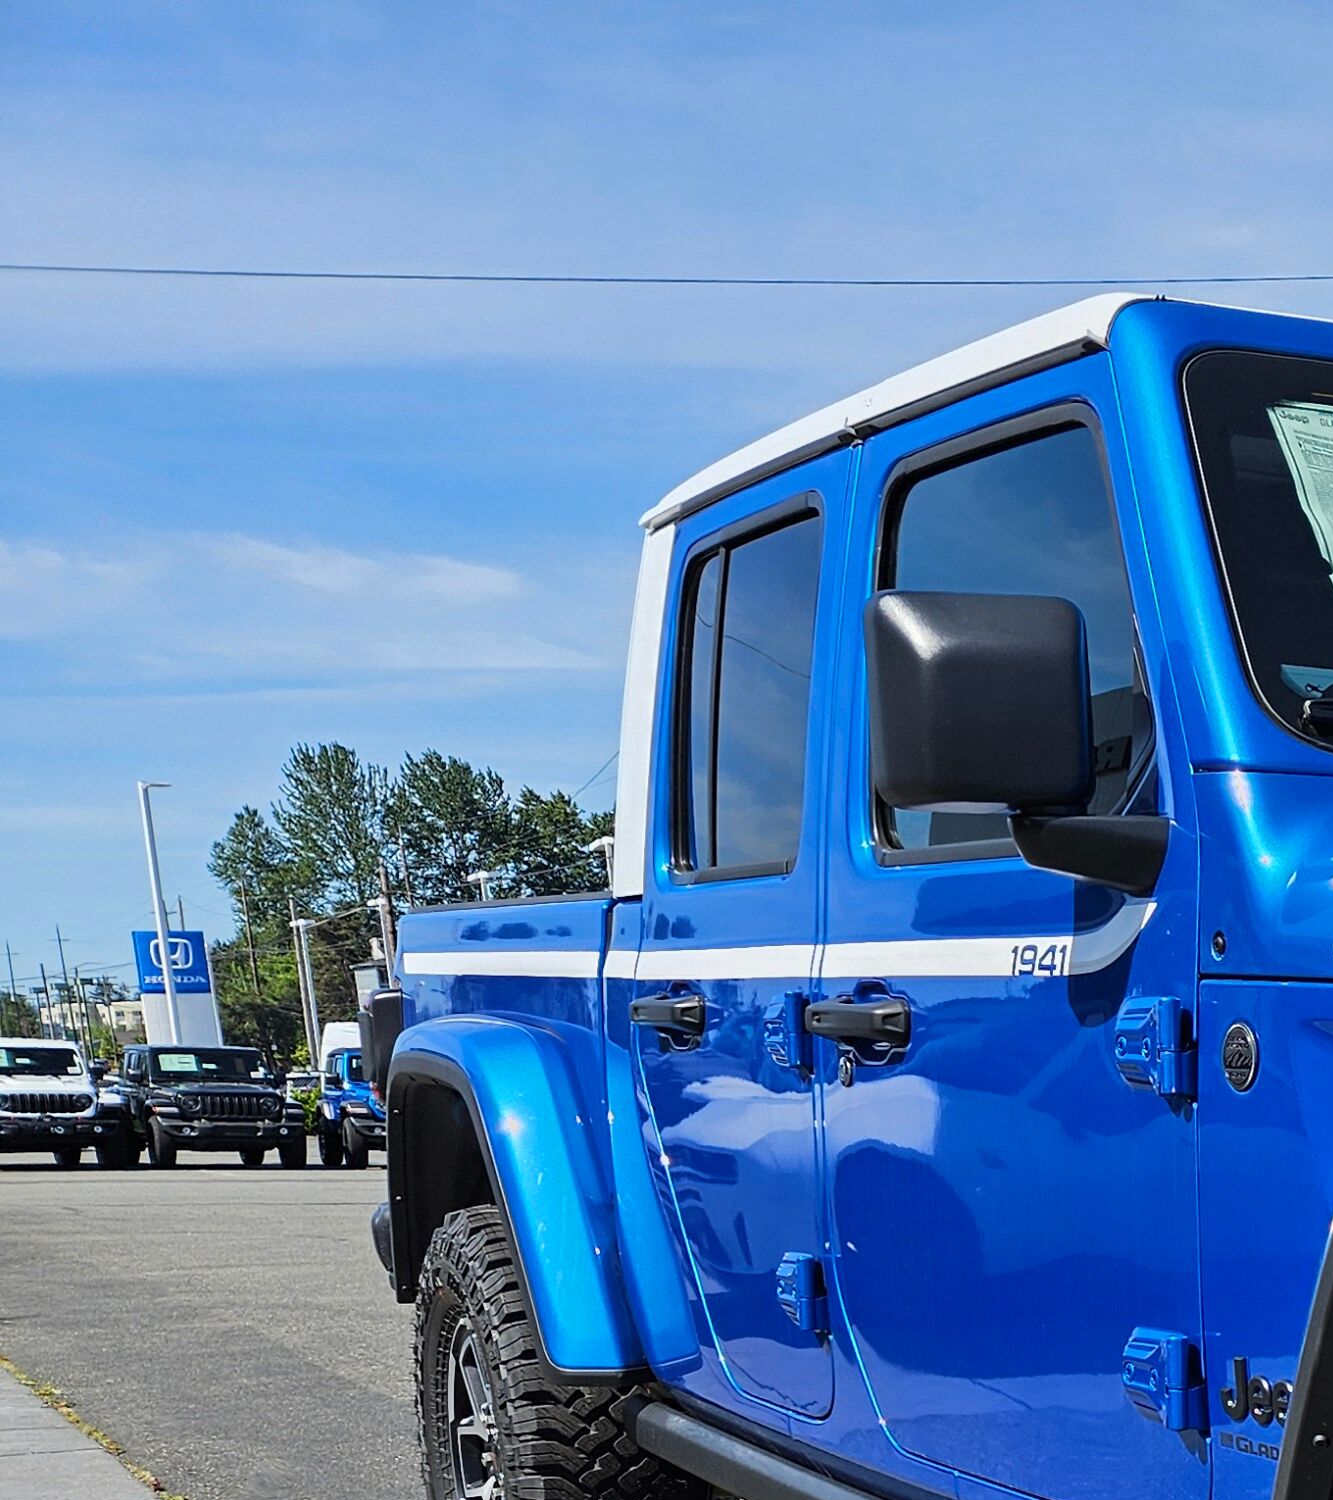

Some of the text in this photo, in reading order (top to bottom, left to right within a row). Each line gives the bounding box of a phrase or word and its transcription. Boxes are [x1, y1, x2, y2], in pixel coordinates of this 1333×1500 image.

[1011, 944, 1067, 977] 1941
[1220, 1356, 1293, 1428] Jee
[1235, 1435, 1280, 1461] GLAD
